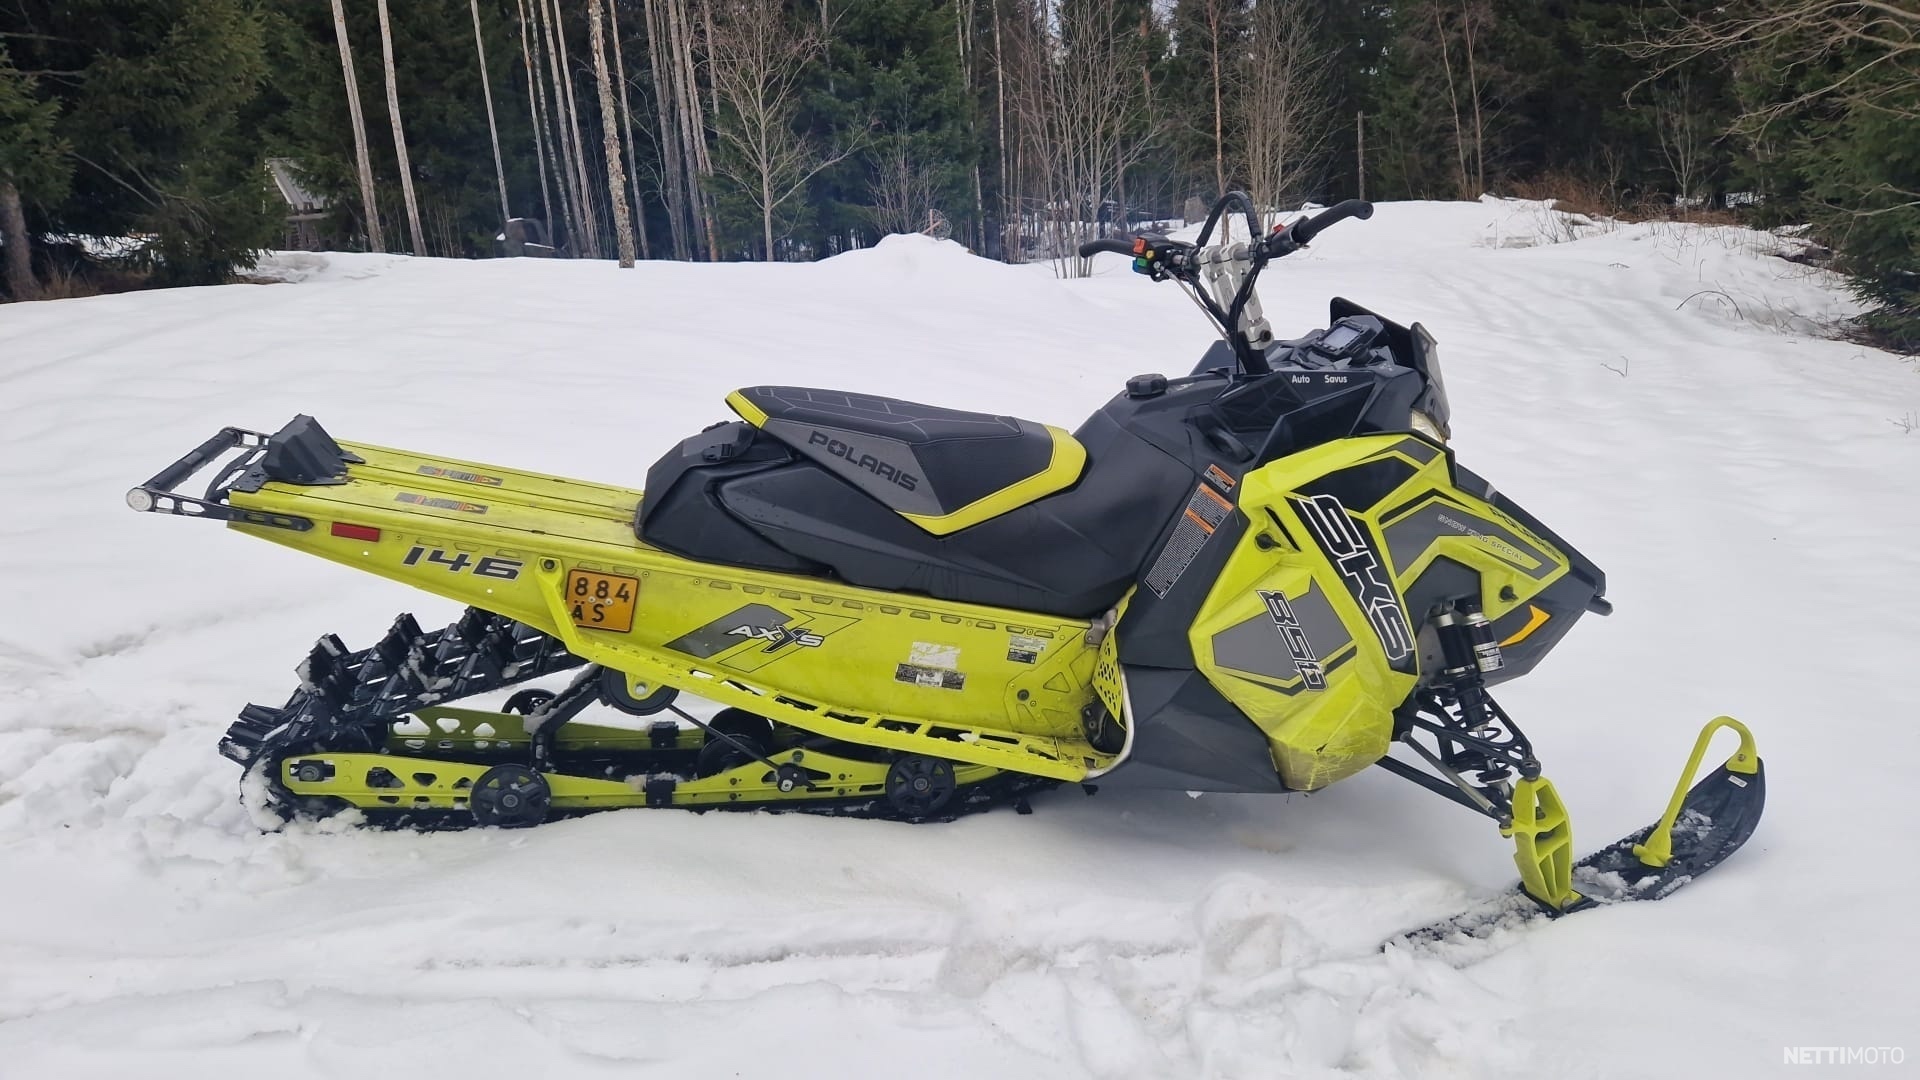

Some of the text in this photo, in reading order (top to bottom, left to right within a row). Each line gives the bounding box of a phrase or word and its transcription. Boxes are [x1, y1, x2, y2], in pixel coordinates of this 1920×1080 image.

[1291, 374, 1311, 384] Auto
[1324, 374, 1348, 384] Savus
[808, 430, 919, 492] POLARIS
[402, 545, 524, 581] 146
[1490, 540, 1523, 561] SPECIAL
[575, 577, 630, 602] 884
[1297, 494, 1415, 661] SKS
[572, 600, 605, 622] ÄS
[1256, 590, 1329, 691] 850
